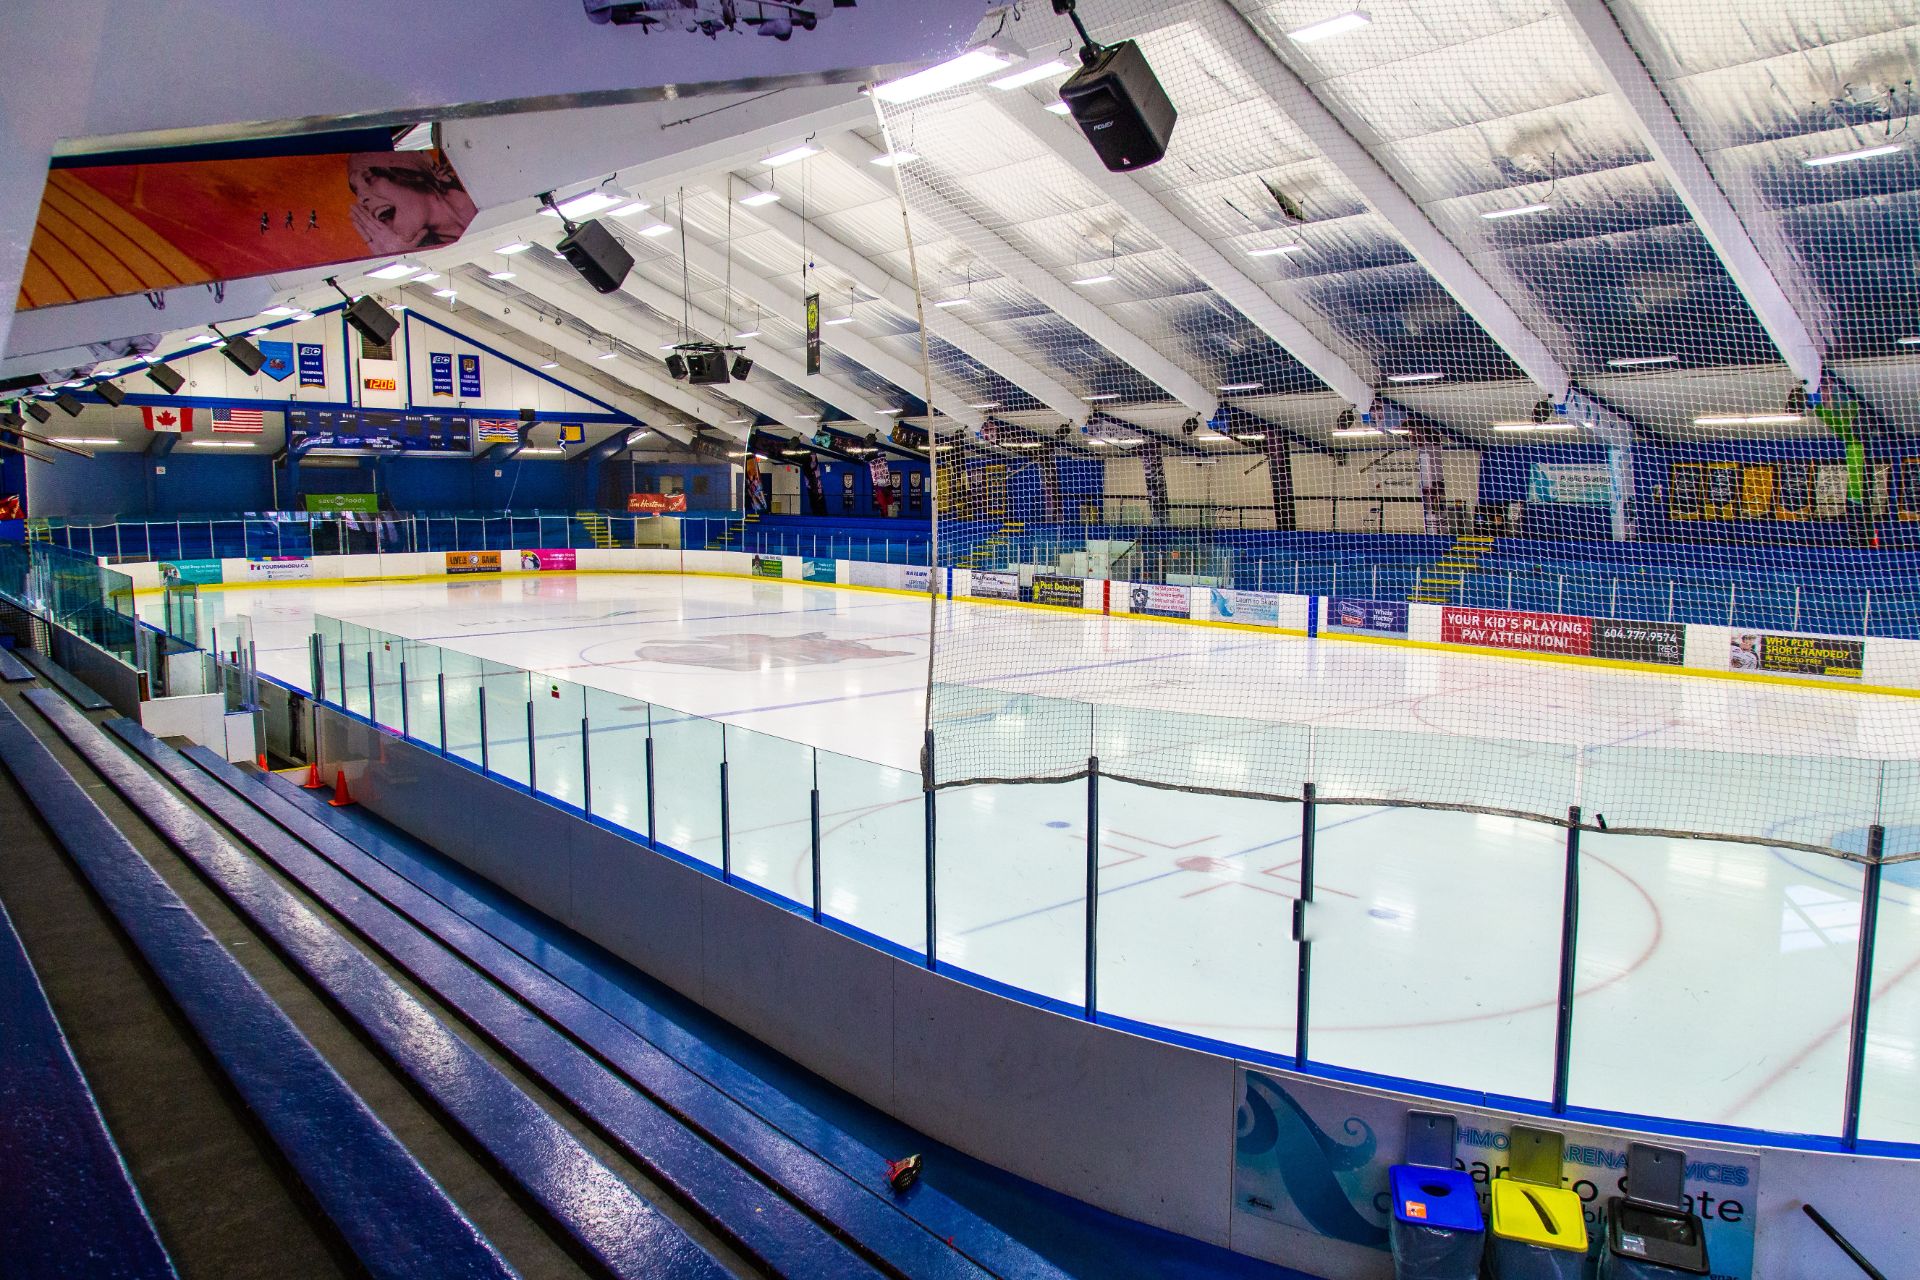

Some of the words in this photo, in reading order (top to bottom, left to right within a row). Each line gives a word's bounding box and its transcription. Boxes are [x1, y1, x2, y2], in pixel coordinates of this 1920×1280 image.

[1447, 613, 1480, 626] YOUR
[1484, 617, 1519, 629] KID'S
[1461, 628, 1486, 641] PAY
[1489, 632, 1568, 648] ATTENTION!
[1604, 628, 1678, 643] 604.777.9574
[1766, 637, 1788, 646] WHY
[1791, 638, 1815, 648] PLAY
